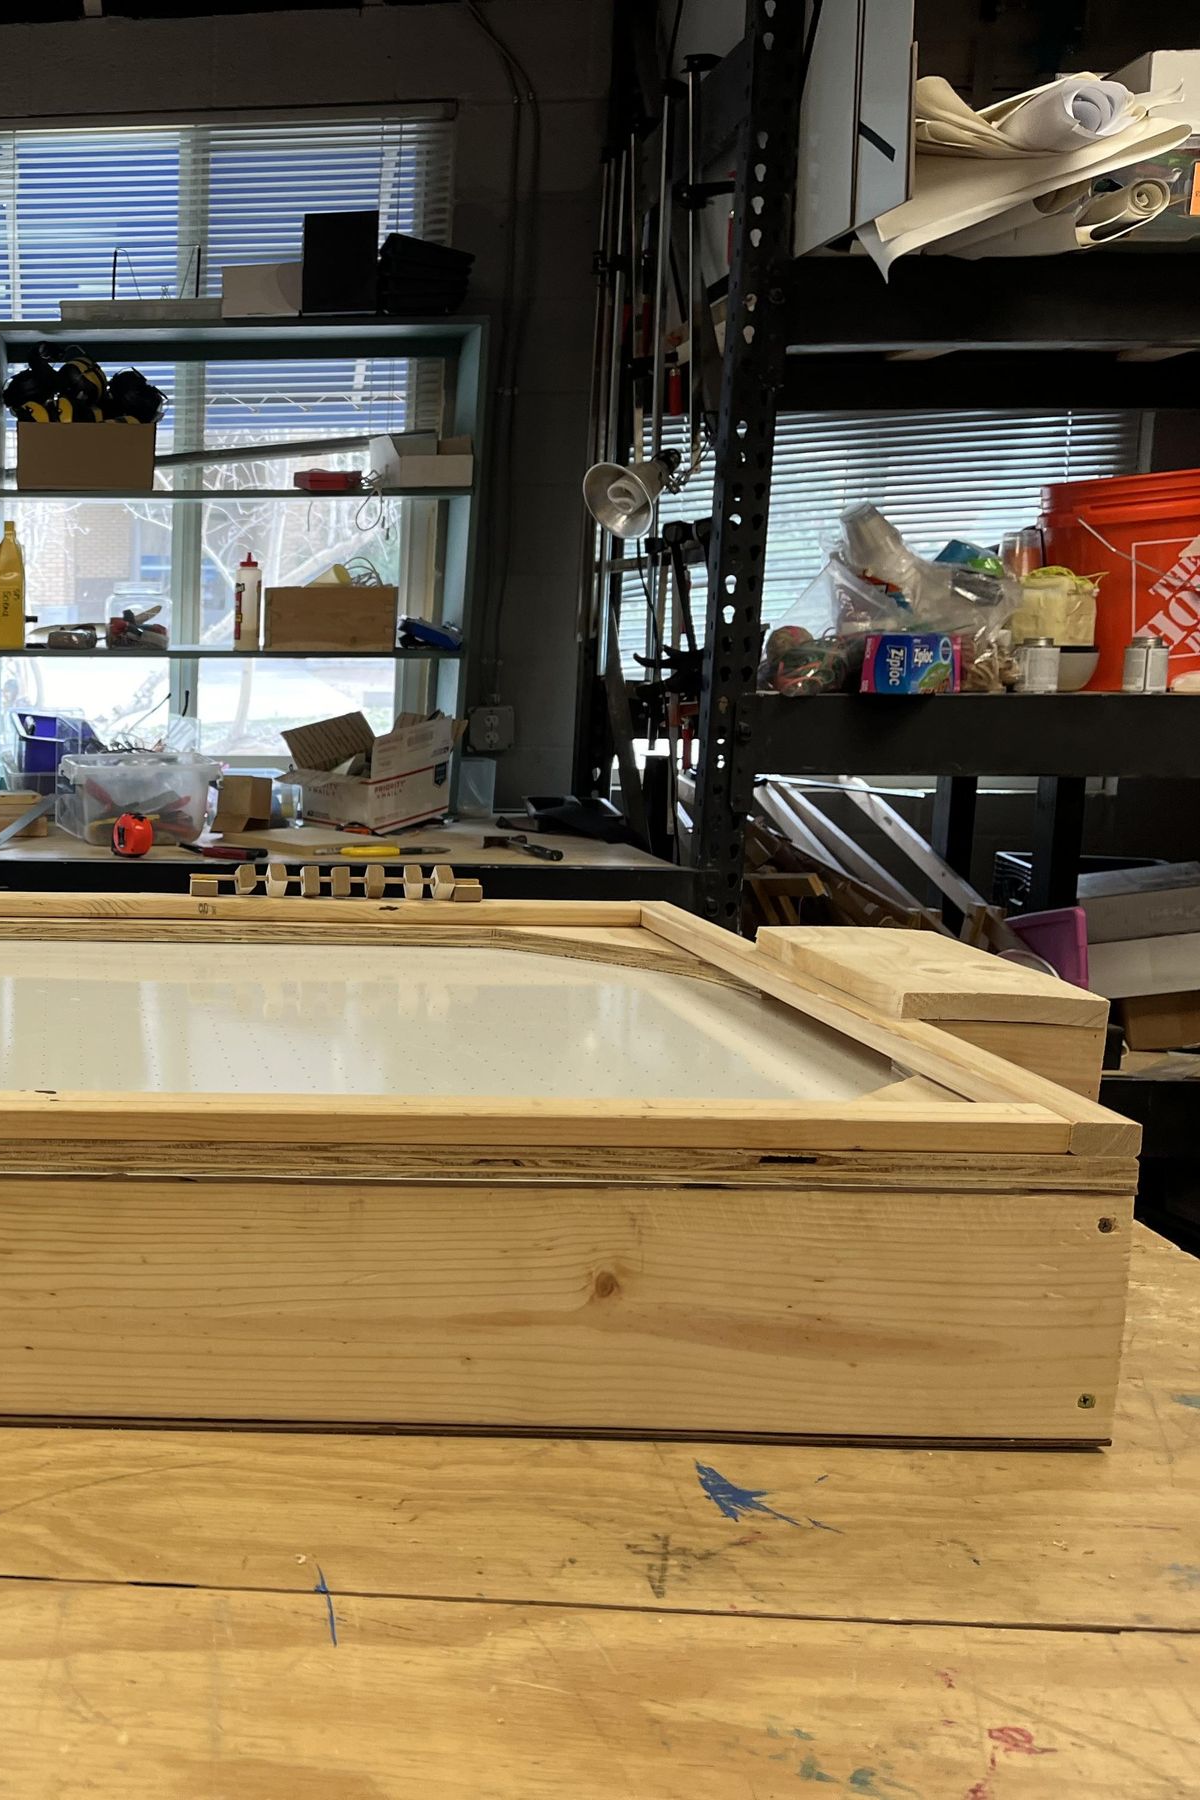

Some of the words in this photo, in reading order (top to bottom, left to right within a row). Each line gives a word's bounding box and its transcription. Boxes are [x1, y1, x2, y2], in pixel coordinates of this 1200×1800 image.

[1134, 574, 1200, 650] HO
[886, 648, 904, 686] Ziploc
[914, 648, 933, 667] Ziploc
[374, 780, 405, 793] PRIORITY
